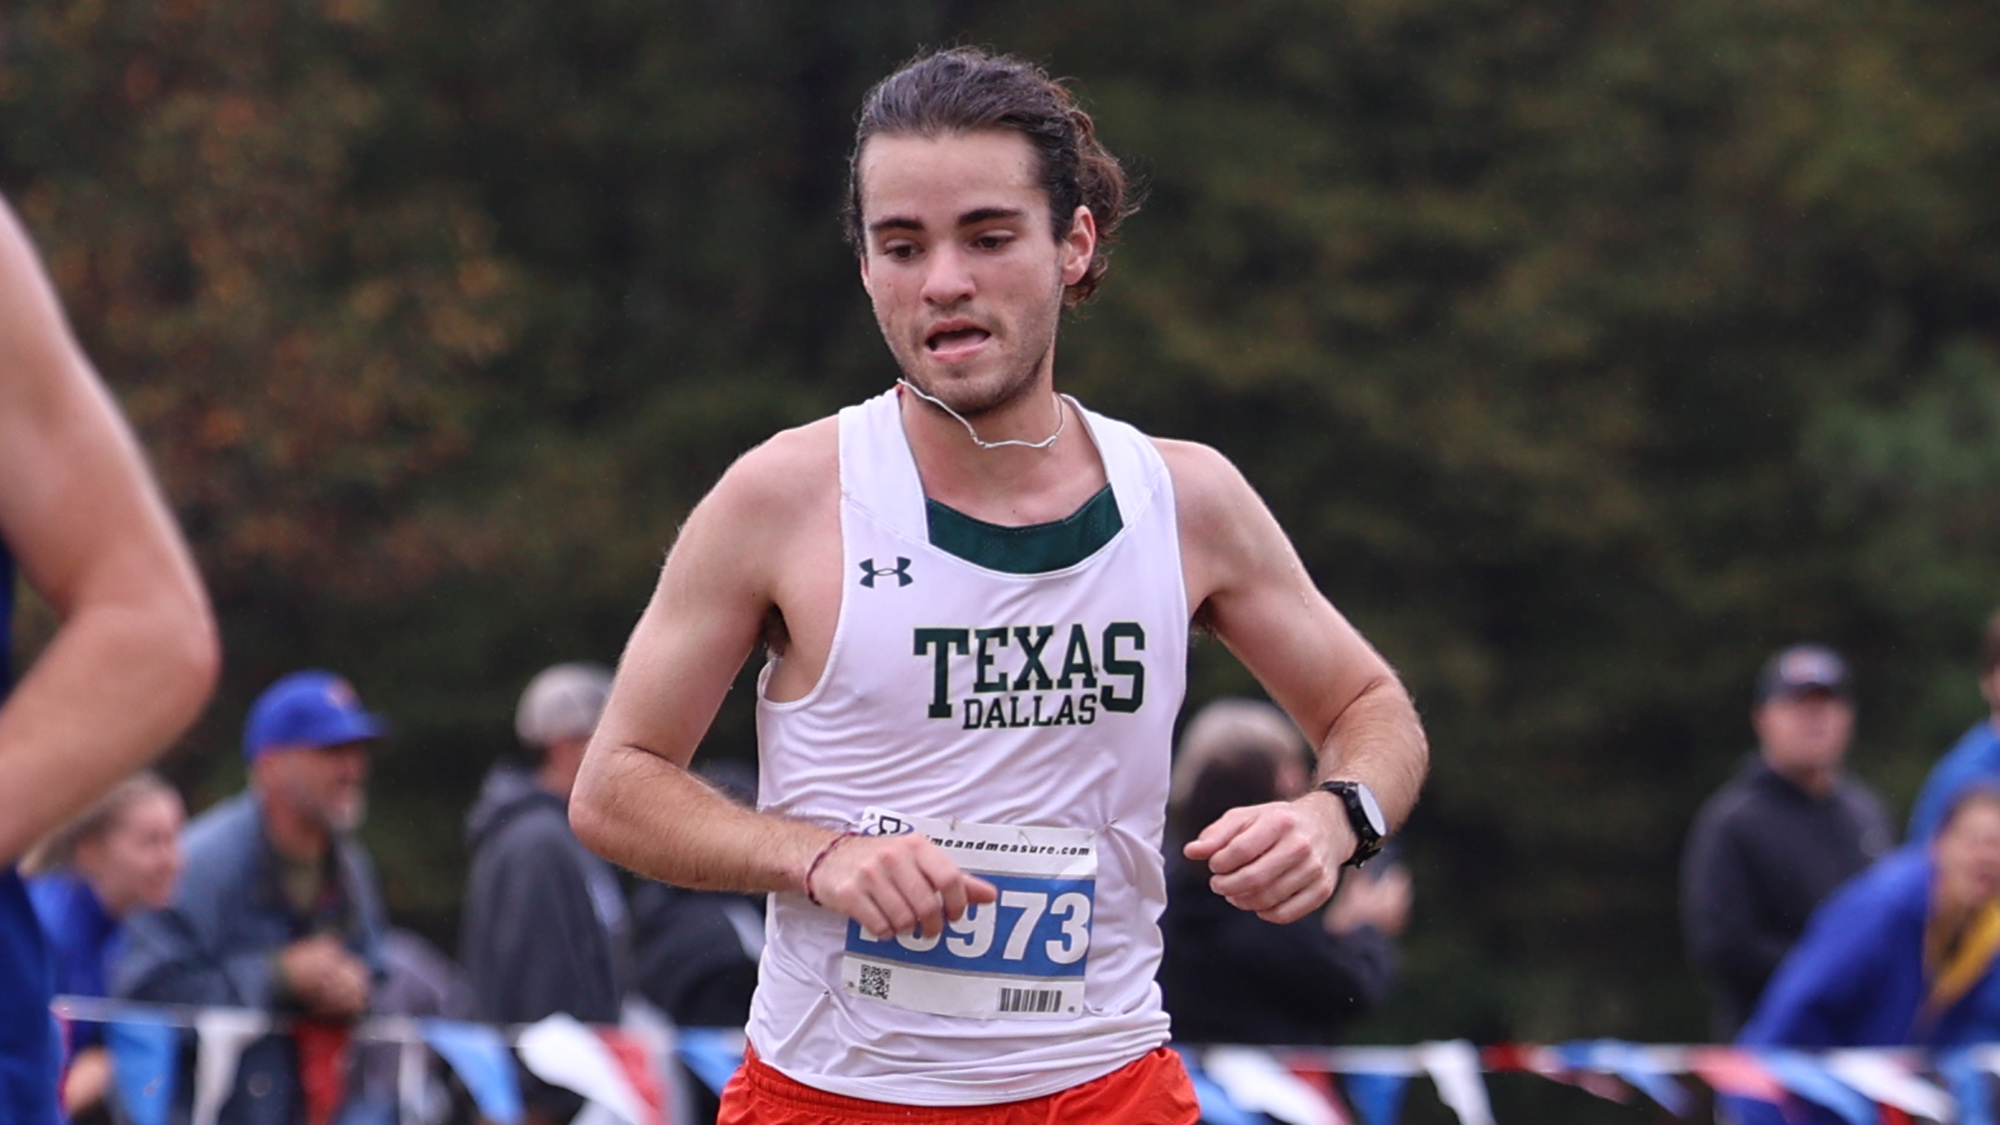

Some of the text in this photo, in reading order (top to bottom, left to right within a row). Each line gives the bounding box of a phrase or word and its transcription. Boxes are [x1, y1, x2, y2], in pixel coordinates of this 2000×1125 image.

[913, 622, 1145, 718] TEXAS
[962, 694, 1098, 730] DALLAS
[927, 834, 1090, 856] meandmeasure.com
[859, 890, 1091, 965] 973
